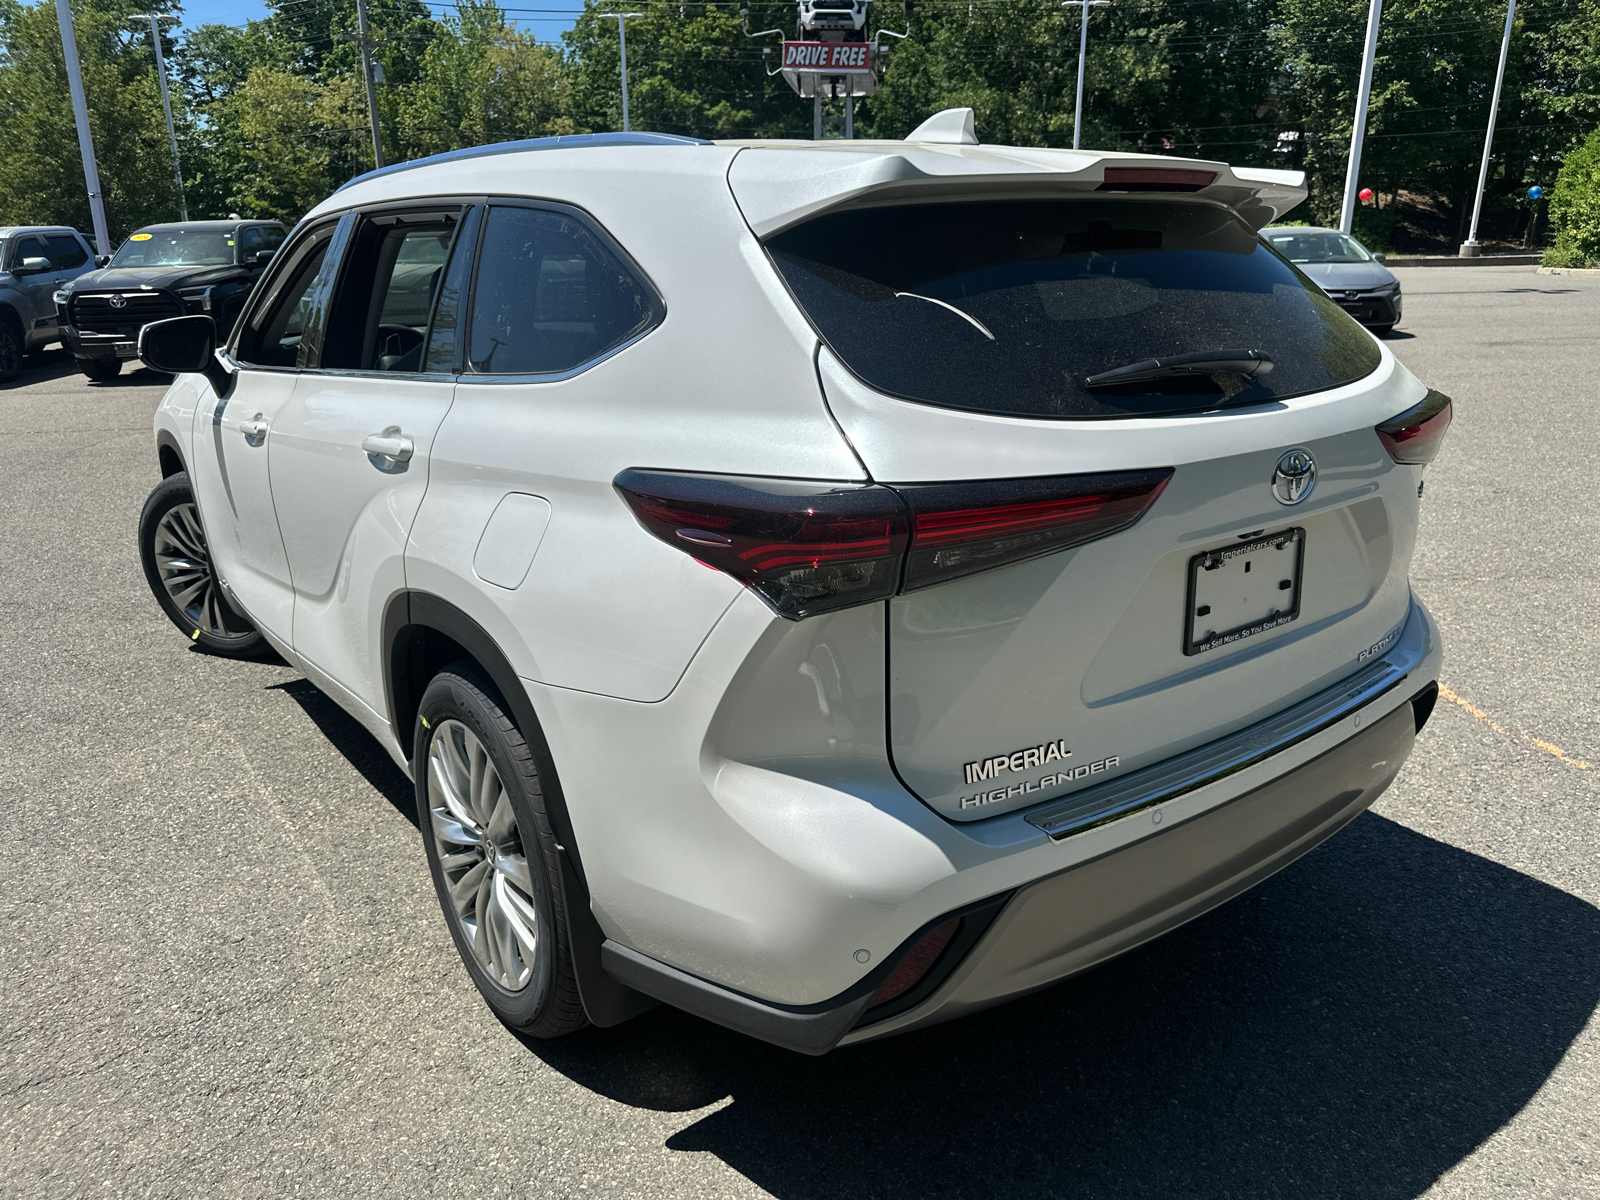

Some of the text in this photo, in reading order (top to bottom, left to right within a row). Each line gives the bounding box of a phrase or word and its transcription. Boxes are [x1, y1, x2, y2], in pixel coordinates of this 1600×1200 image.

[786, 45, 867, 66] DRIVE FREE
[1220, 537, 1284, 559] Imperialcars.com
[1199, 644, 1211, 652] We
[1211, 639, 1223, 649] Sell
[1241, 629, 1250, 638] So
[1251, 625, 1262, 635] You
[1263, 620, 1277, 630] Save
[1277, 615, 1292, 626] More
[963, 739, 1073, 785] IMPERIAL
[959, 755, 1121, 810] HIGHLANDER
